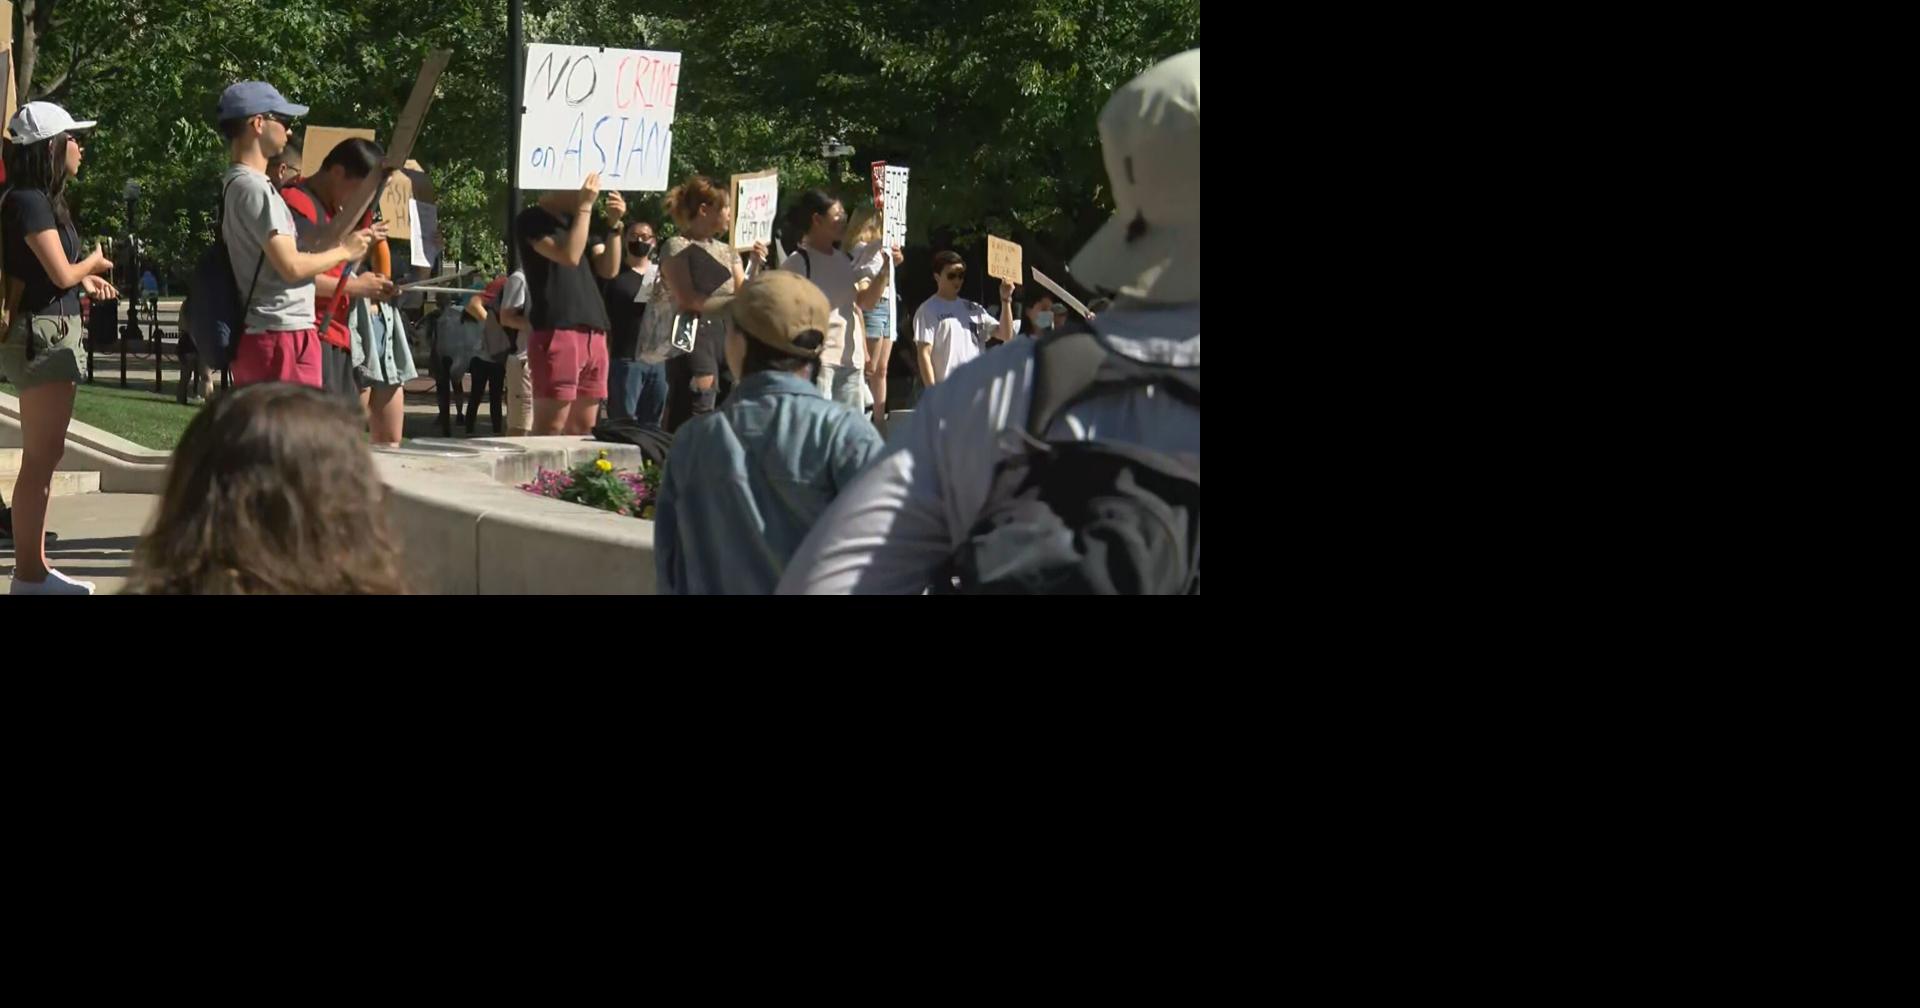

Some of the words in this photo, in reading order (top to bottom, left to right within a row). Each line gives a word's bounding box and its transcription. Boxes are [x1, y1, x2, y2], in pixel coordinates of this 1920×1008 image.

[529, 52, 597, 107] NO
[615, 55, 681, 108] CRIME
[531, 146, 556, 171] on
[559, 112, 669, 180] ASIAN
[387, 183, 407, 205] ASI
